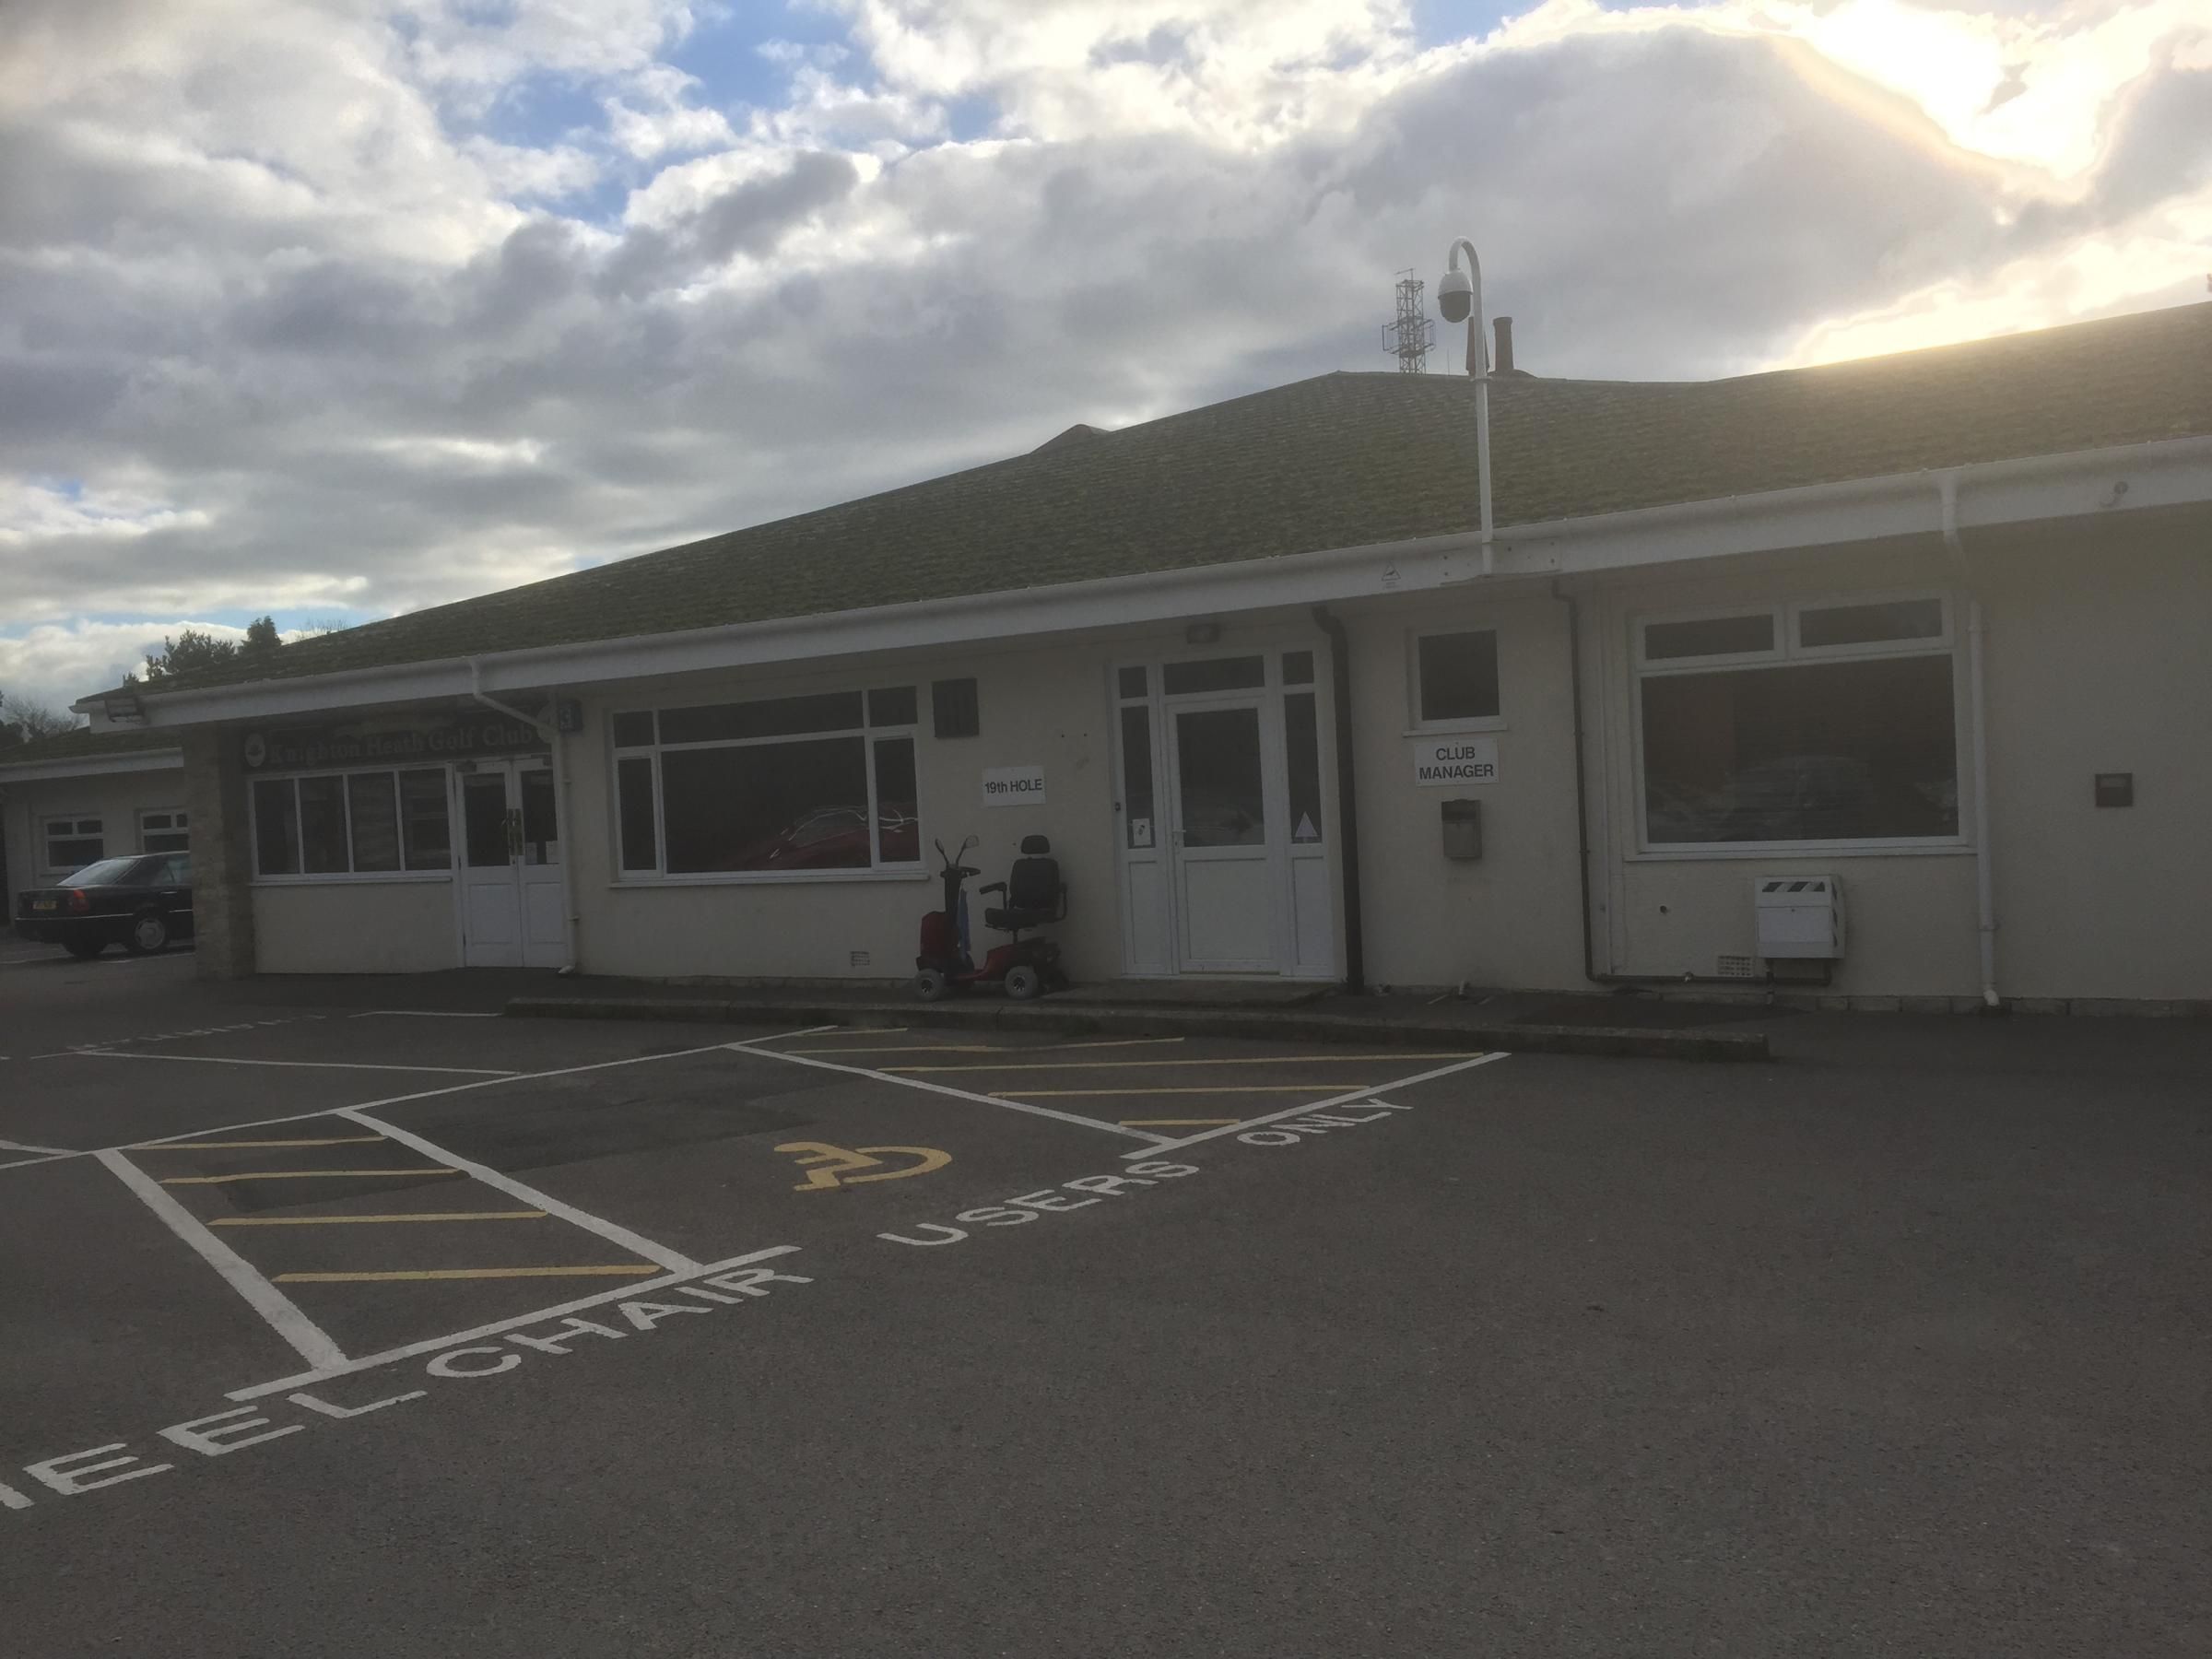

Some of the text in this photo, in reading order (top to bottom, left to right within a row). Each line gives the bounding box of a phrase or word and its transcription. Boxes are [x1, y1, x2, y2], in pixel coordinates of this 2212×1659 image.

[270, 723, 533, 766] Knighton Heath Golf Club
[1436, 747, 1476, 760] CLUB
[1419, 764, 1494, 780] MANAGER
[984, 779, 1042, 794] 19th HOLE
[0, 1098, 1413, 1509] EELCHAIR USERS ONLY
